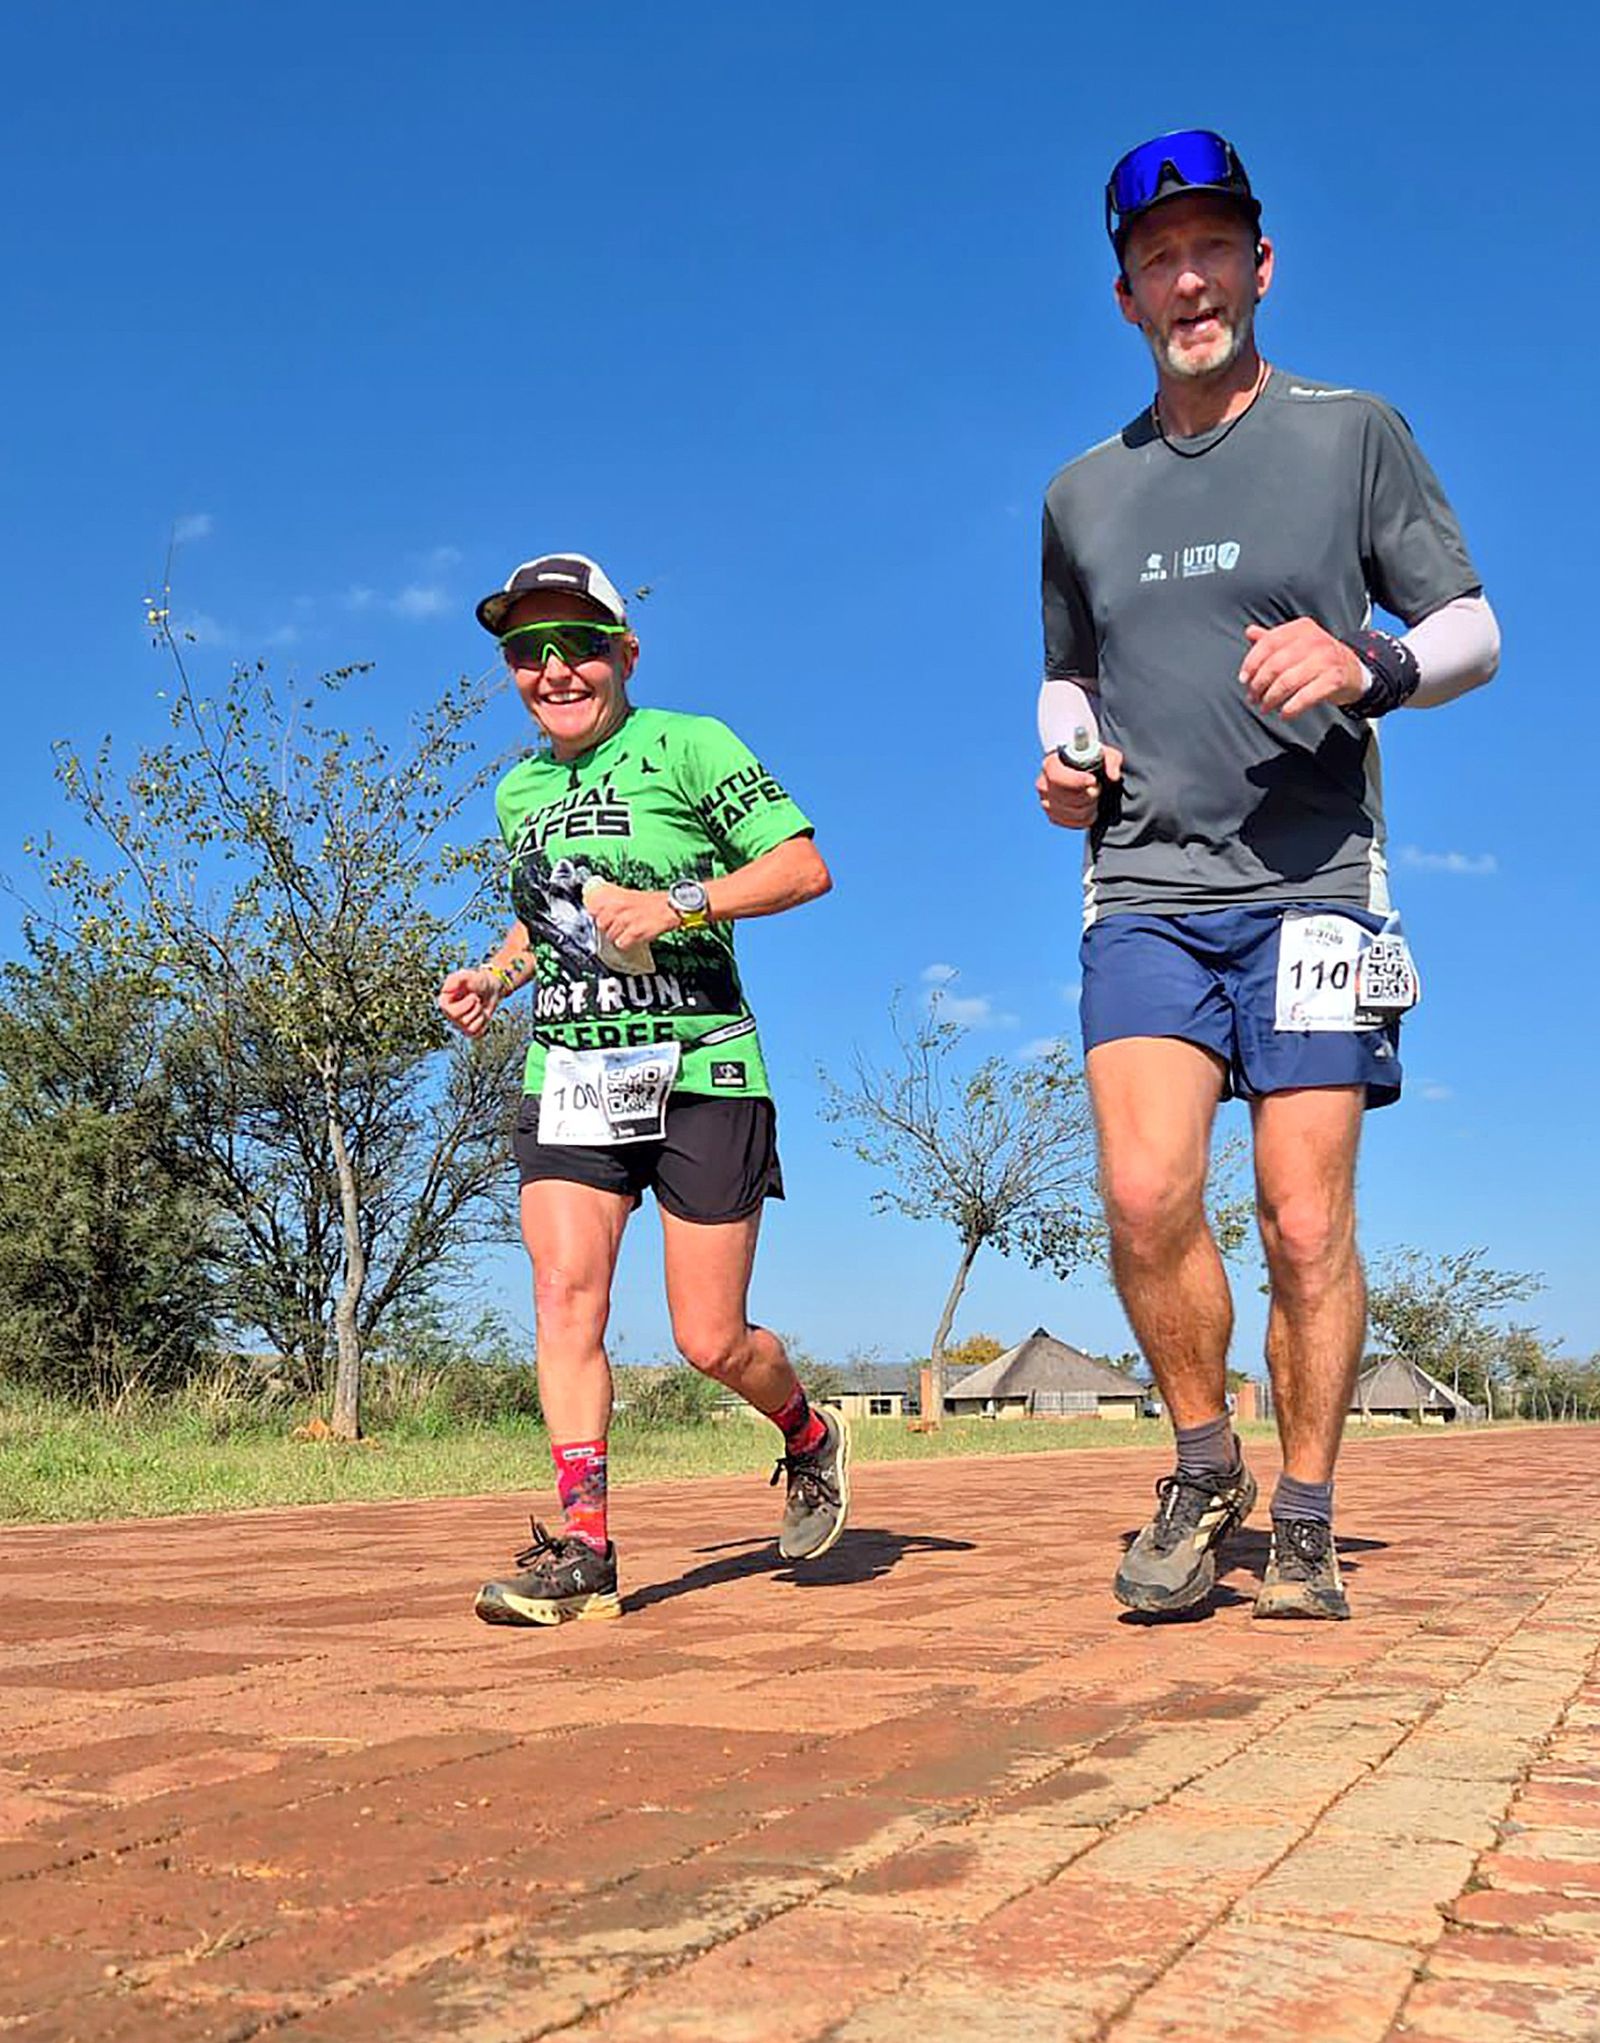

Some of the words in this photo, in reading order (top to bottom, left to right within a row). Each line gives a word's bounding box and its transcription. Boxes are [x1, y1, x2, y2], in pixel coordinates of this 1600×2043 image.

[1290, 960, 1349, 990] 110
[534, 981, 588, 1018] JUST
[553, 1083, 599, 1111] 100
